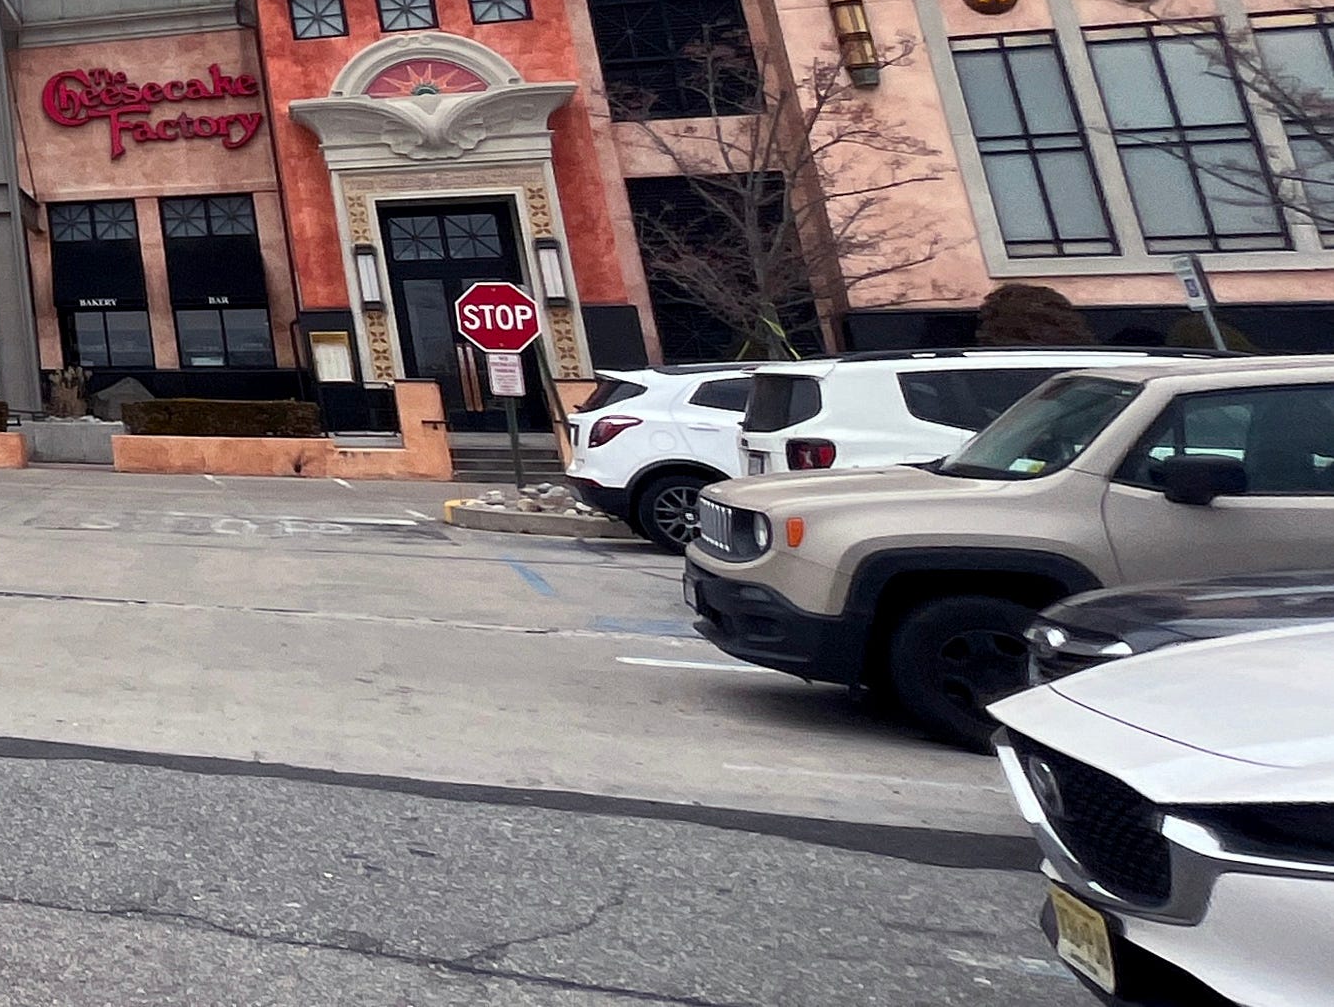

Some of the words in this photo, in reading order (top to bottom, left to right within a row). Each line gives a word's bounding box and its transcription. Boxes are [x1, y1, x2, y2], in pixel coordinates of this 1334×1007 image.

[88, 67, 127, 84] The
[42, 63, 259, 126] Cheesecake
[87, 104, 263, 161] Factory
[79, 298, 117, 307] BAKERY
[208, 296, 229, 304] BAR
[463, 304, 533, 330] STOP
